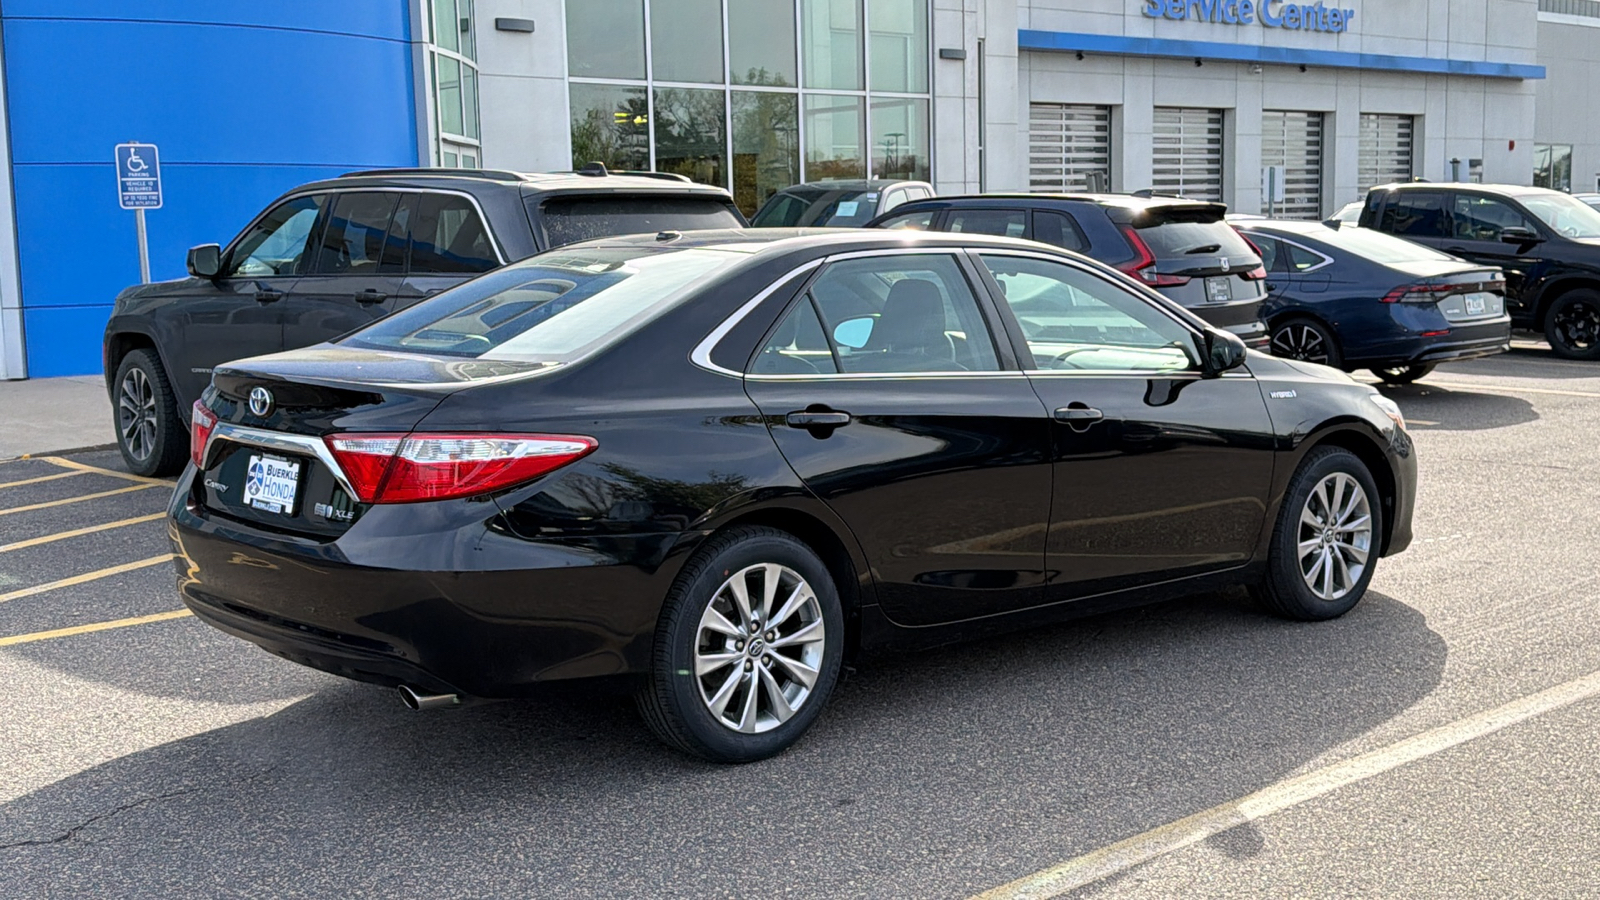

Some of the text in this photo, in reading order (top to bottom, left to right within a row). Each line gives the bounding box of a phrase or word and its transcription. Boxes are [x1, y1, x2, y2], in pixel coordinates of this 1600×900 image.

[1143, 0, 1354, 32] Service Center
[1269, 391, 1293, 399] HYBRID
[266, 464, 299, 480] BUERKLE
[262, 476, 295, 501] HONDA
[335, 509, 355, 519] XLE
